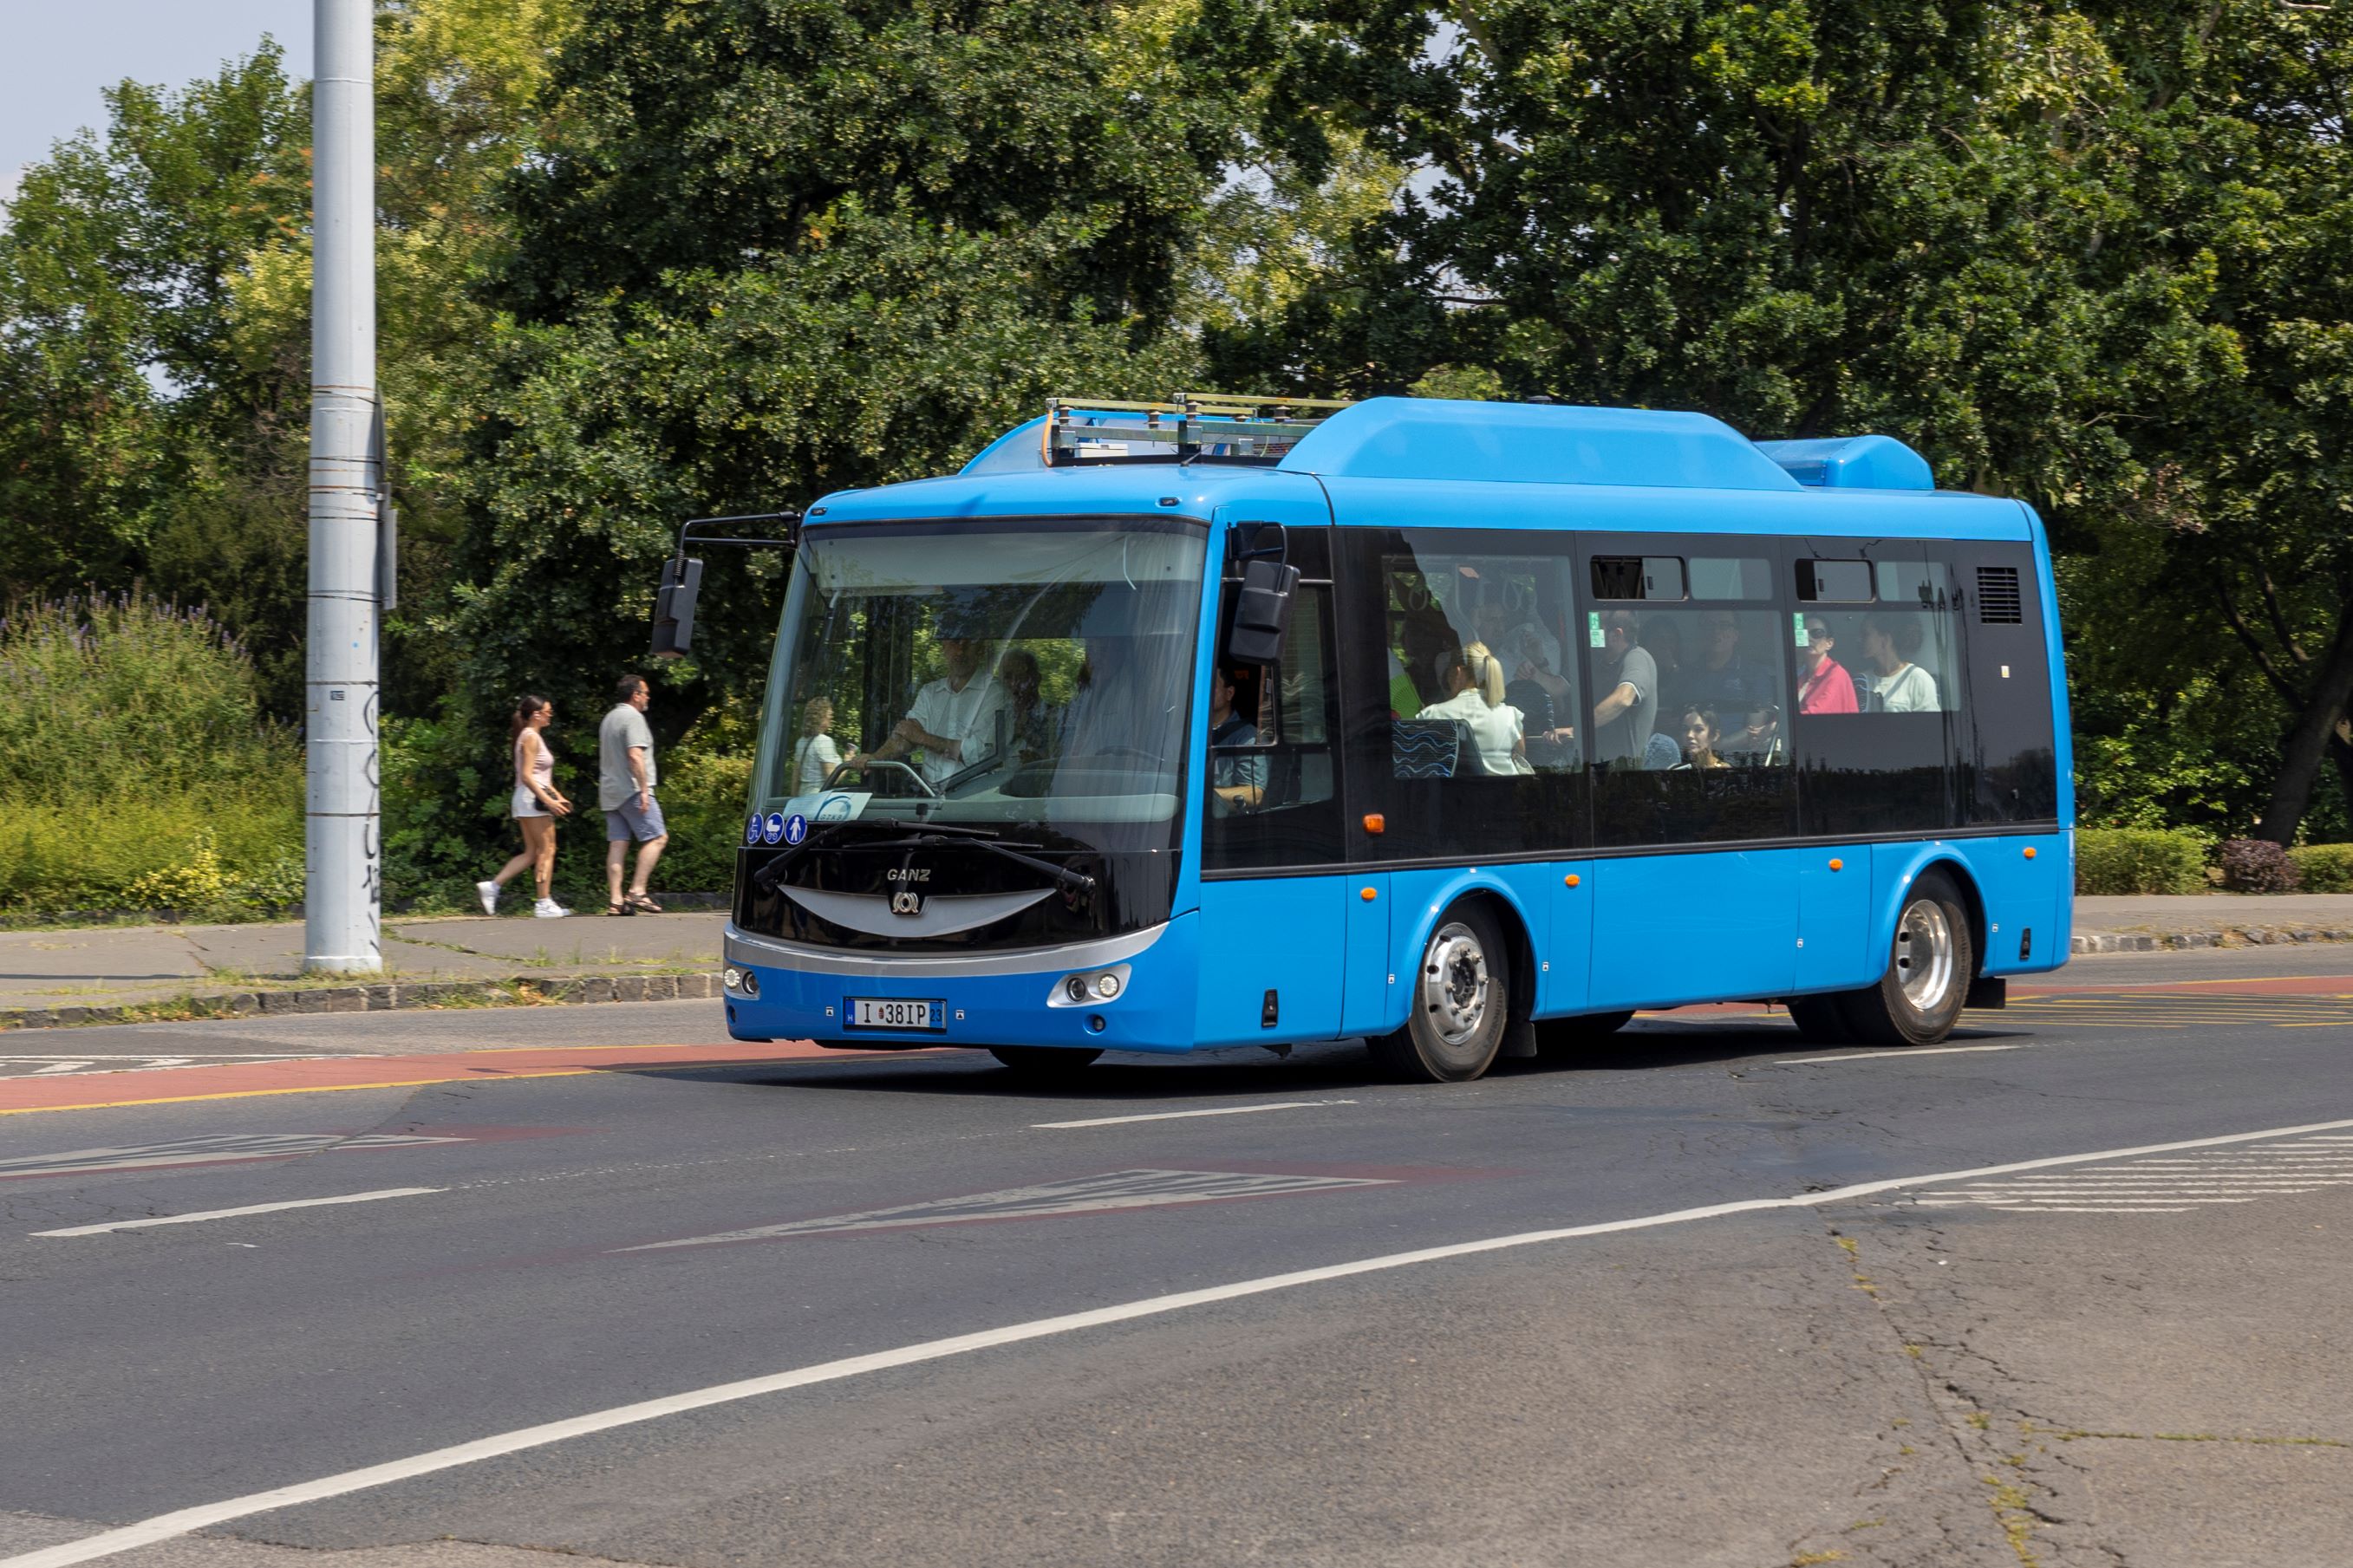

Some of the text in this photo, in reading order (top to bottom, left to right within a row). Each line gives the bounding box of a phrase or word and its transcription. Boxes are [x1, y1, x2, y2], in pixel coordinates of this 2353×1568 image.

[887, 868, 931, 882] GANZ
[885, 1004, 926, 1025] 38IP
[929, 1009, 942, 1022] 23
